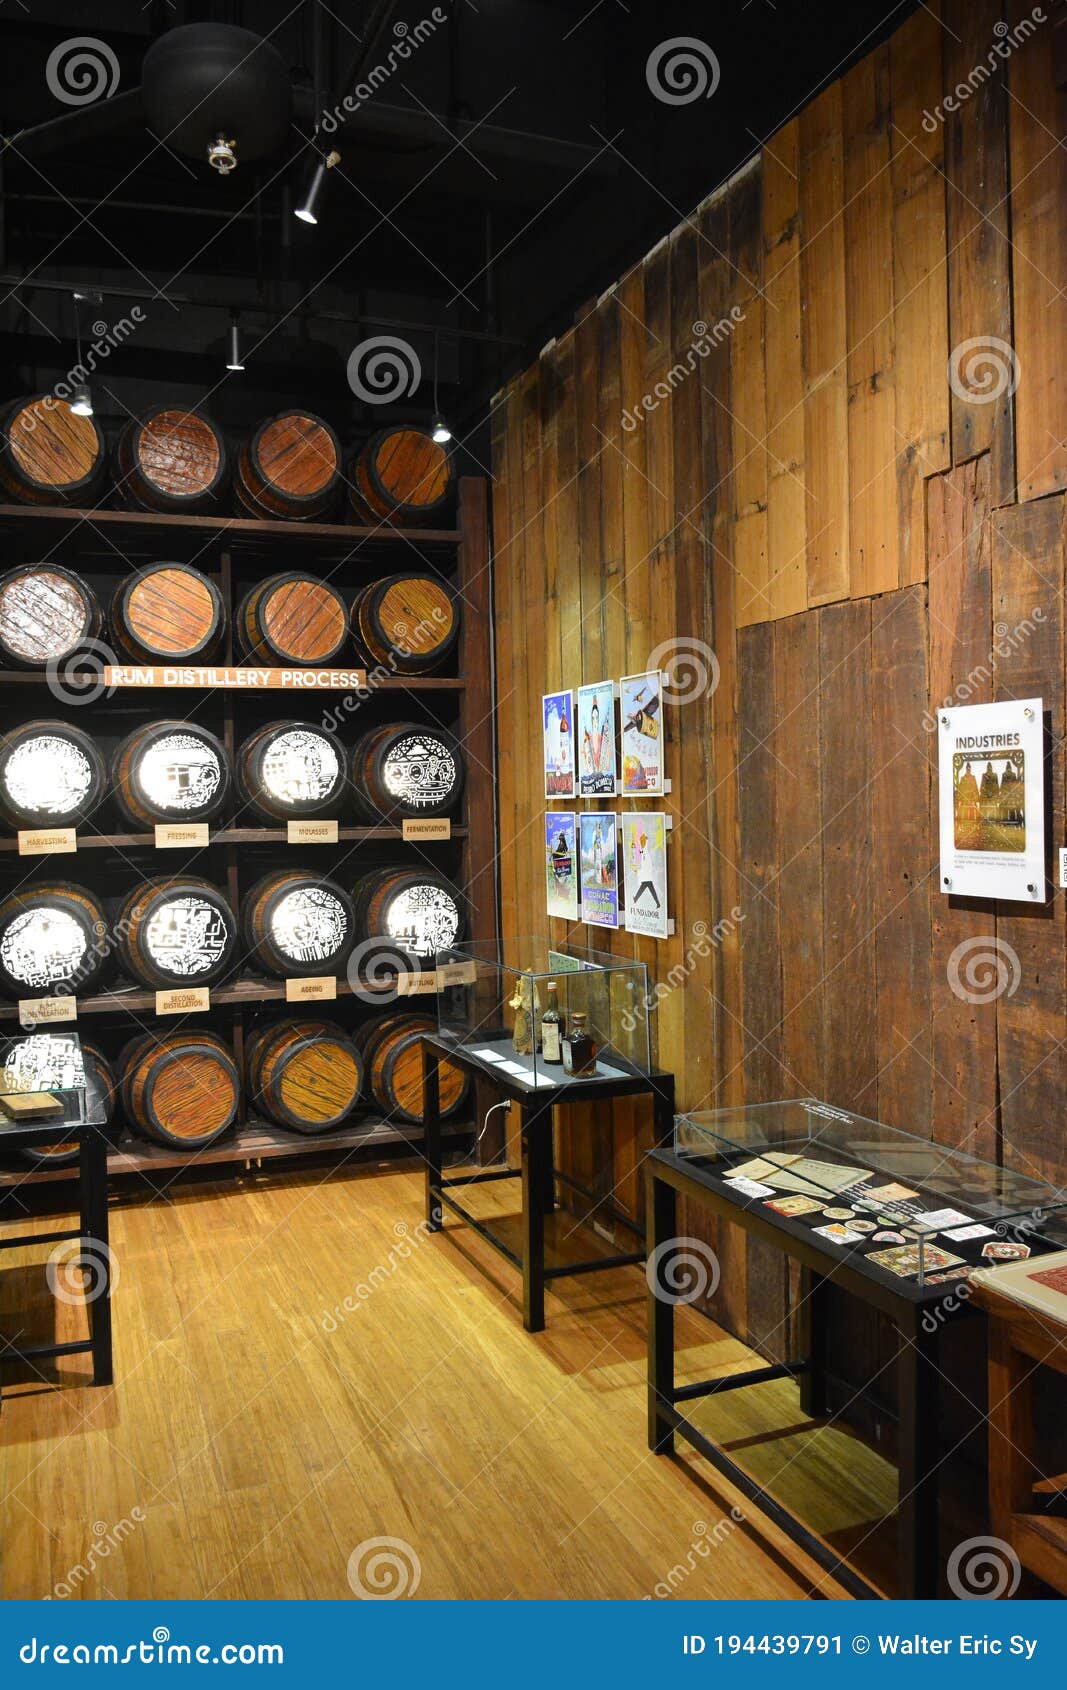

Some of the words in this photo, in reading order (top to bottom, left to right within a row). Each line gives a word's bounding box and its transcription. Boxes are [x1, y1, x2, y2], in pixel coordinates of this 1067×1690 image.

[111, 668, 154, 684] RUM
[164, 669, 271, 686] DISTILLERY
[281, 671, 359, 688] PROCESS
[955, 732, 1020, 749] INDUSTRIES
[406, 825, 447, 833] FERMENTATION
[26, 837, 68, 846] HARVESTING
[163, 1000, 203, 1010] DISTILLATION
